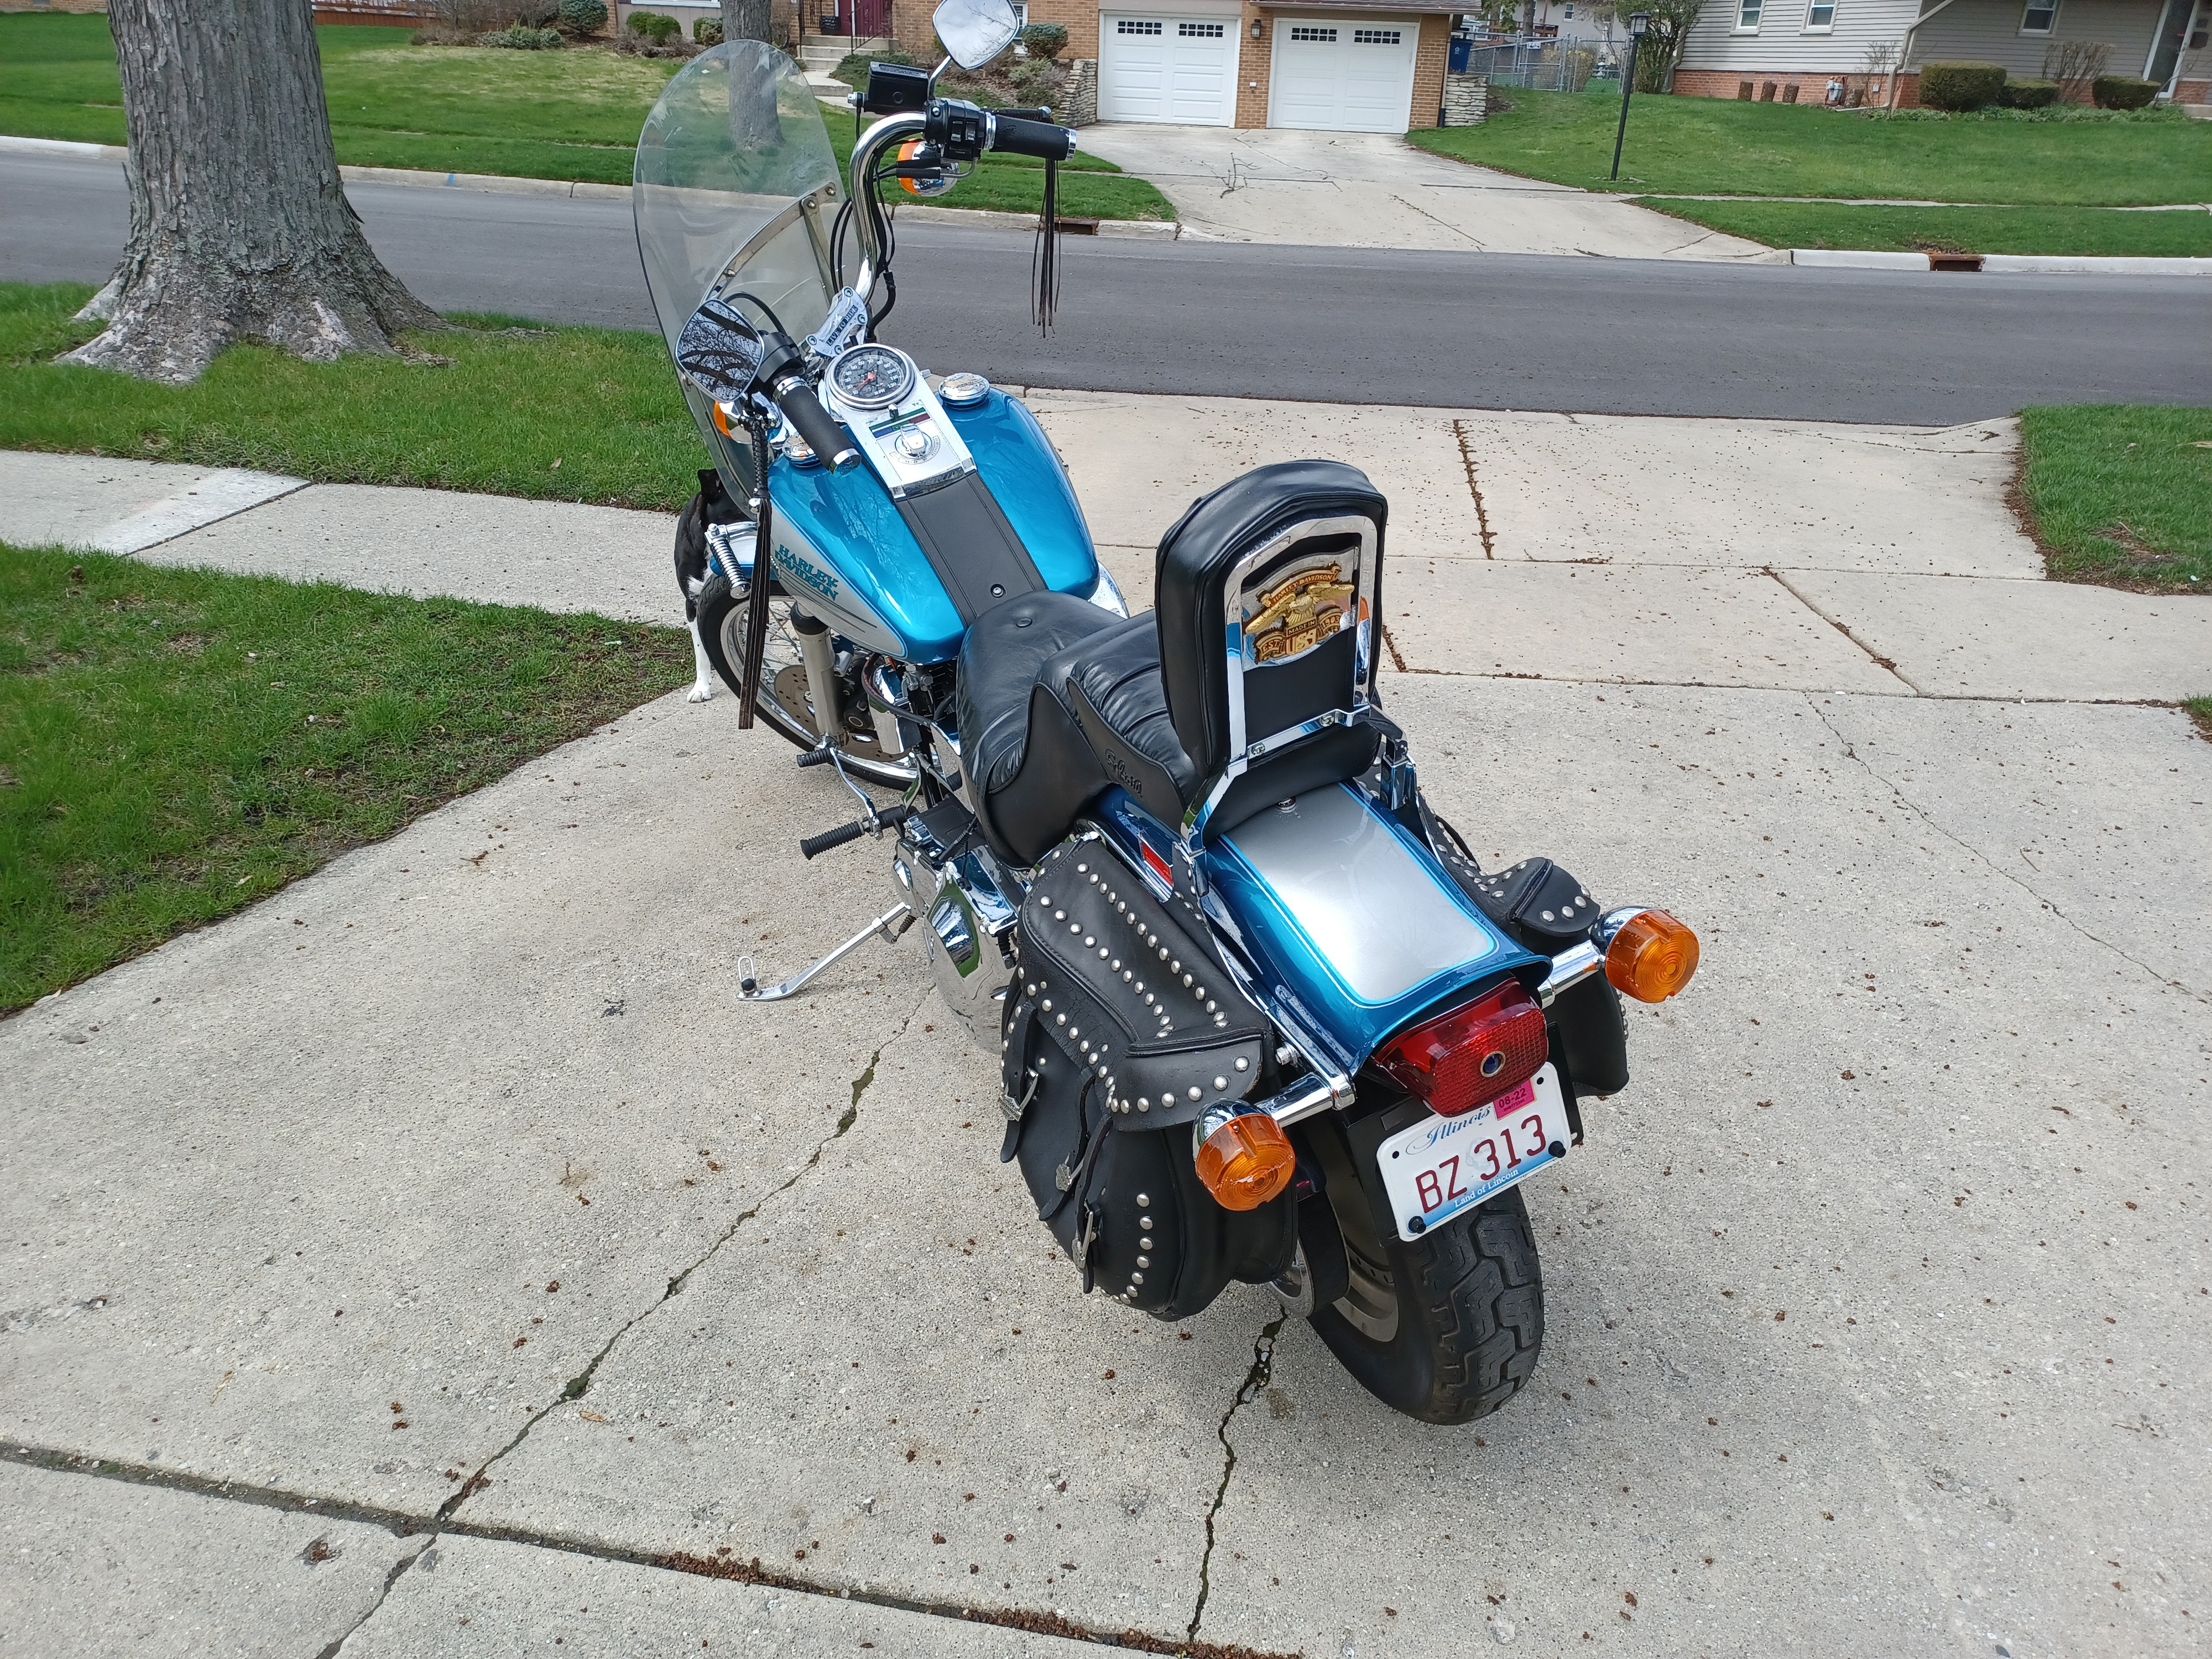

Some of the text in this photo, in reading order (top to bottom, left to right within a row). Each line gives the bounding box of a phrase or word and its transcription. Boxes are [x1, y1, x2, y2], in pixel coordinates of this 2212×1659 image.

[827, 305, 858, 345] LIVE TO RIDE
[775, 549, 839, 601] DAVIDSON
[779, 544, 838, 588] HARLEY
[1288, 623, 1307, 634] MADE
[1321, 615, 1339, 628] 1903
[1286, 629, 1316, 655] USA
[1499, 1088, 1526, 1108] 08-22
[1405, 1106, 1491, 1155] Illinois
[1415, 1114, 1547, 1214] BZ 313
[1454, 1169, 1520, 1208] Land of Lincoln
